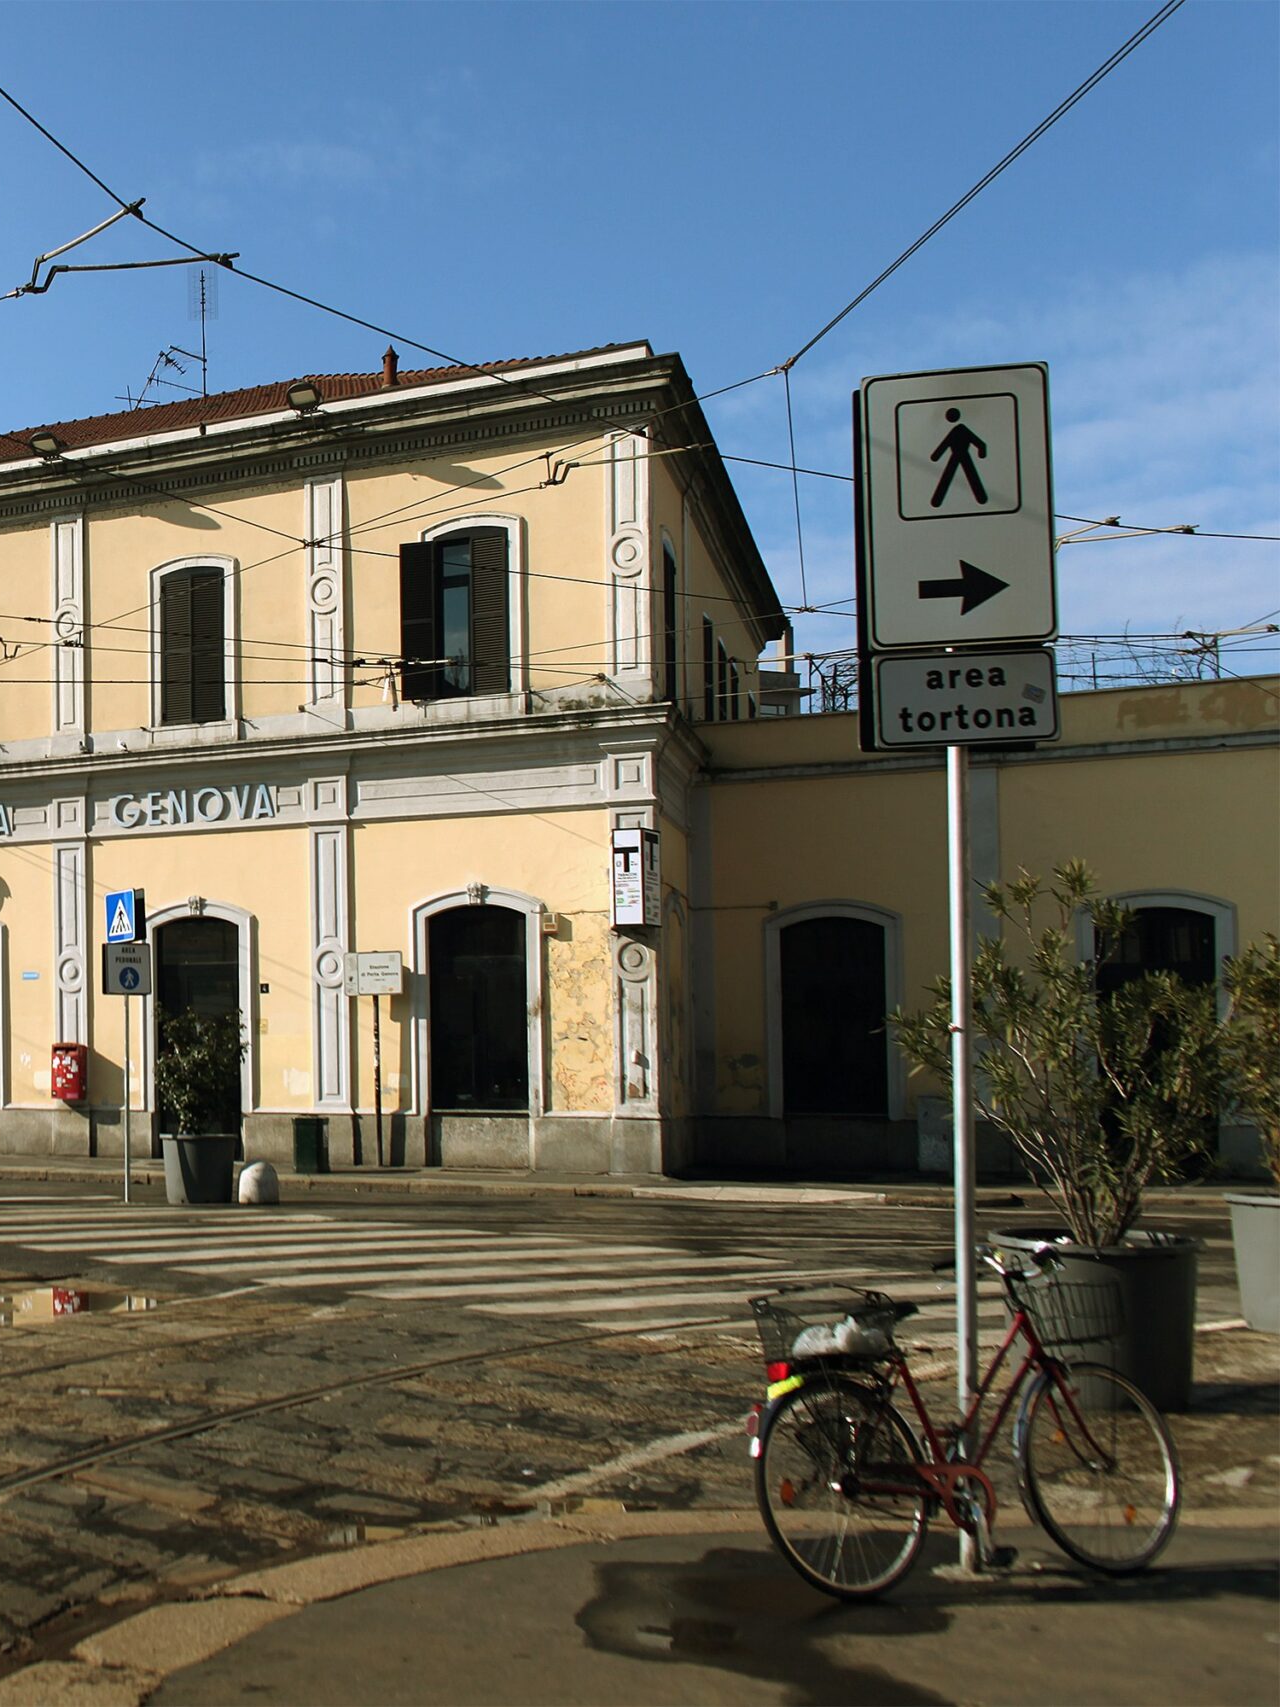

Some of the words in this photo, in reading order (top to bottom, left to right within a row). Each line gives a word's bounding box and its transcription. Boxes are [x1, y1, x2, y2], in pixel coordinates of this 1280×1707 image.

[926, 667, 1006, 690] area
[899, 704, 1036, 732] tortona
[113, 784, 274, 828] GENOVA
[614, 846, 639, 872] T
[645, 831, 658, 870] T
